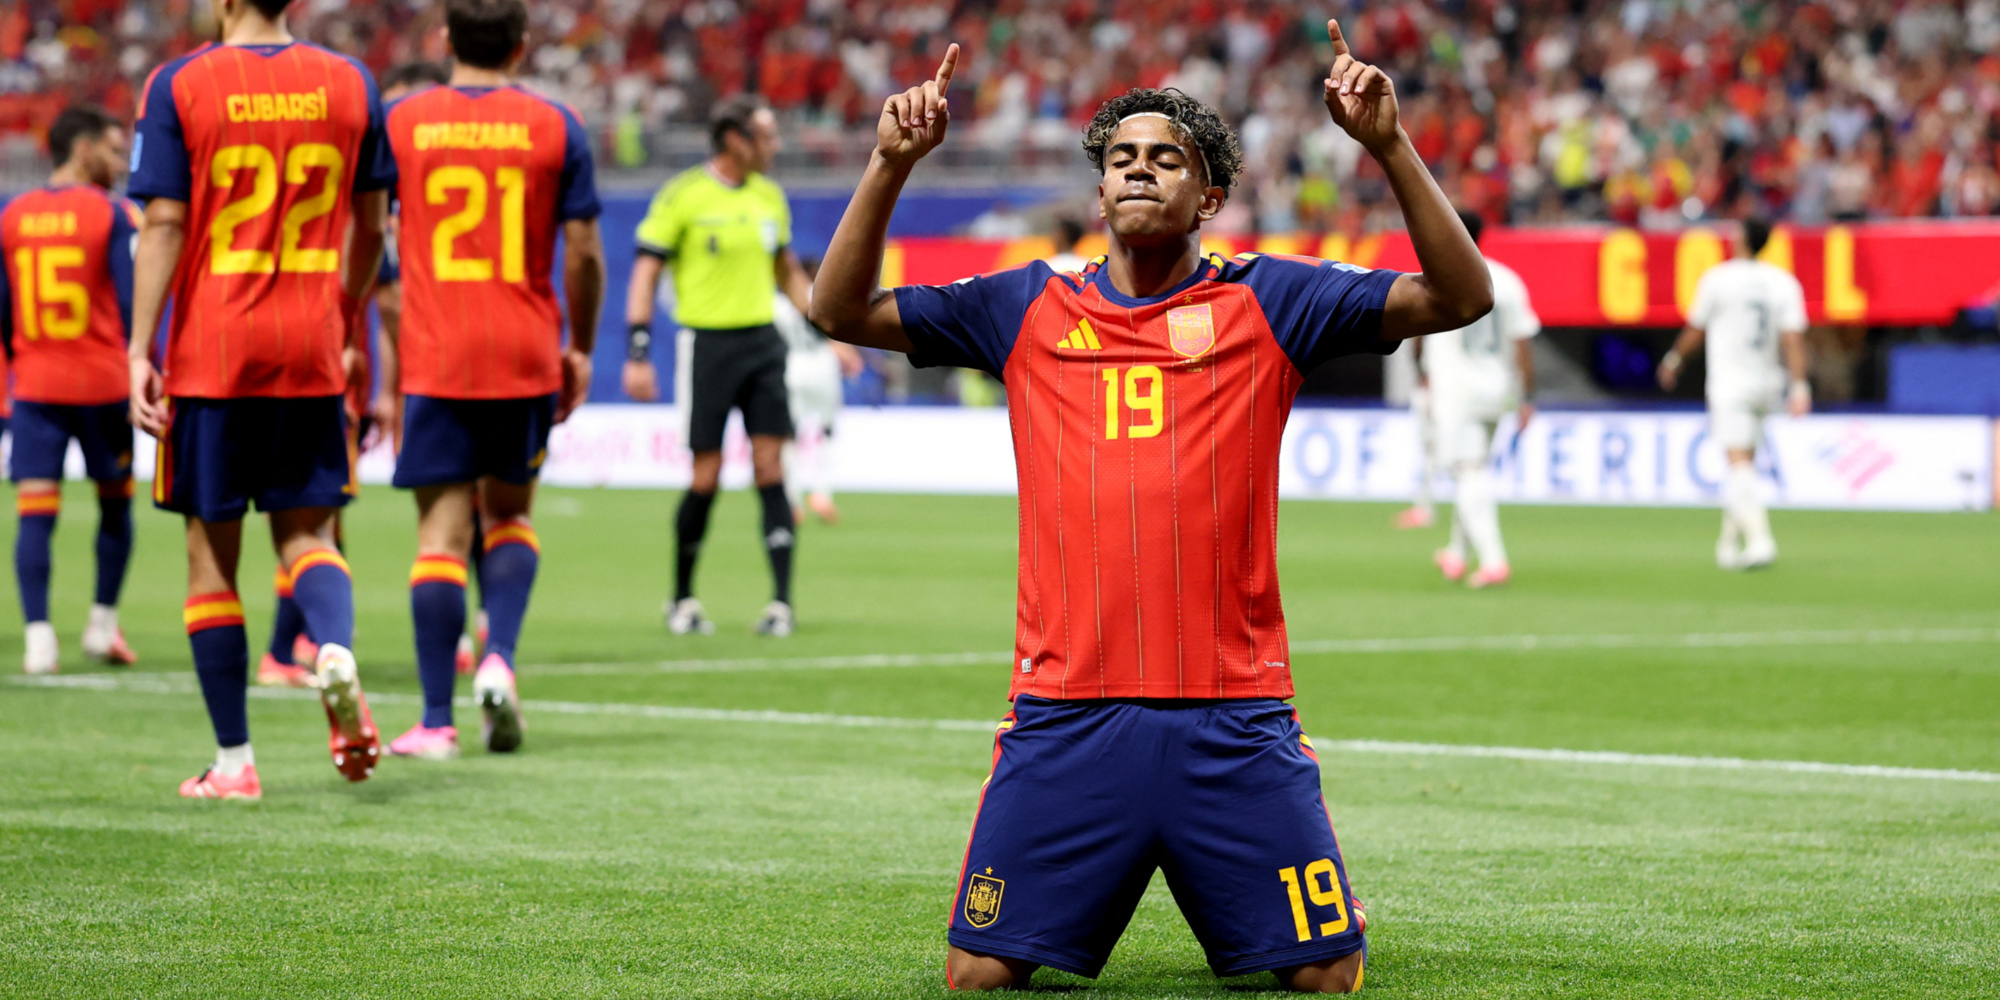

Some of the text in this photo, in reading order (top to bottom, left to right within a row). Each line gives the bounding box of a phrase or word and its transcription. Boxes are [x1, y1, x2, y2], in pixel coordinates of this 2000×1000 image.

[226, 86, 327, 123] CUBARSÍ
[210, 142, 344, 275] 22
[425, 165, 525, 283] 21
[15, 246, 90, 341] 15
[1102, 365, 1163, 440] 19
[1294, 423, 1379, 488] OF
[1278, 858, 1349, 942] 19
